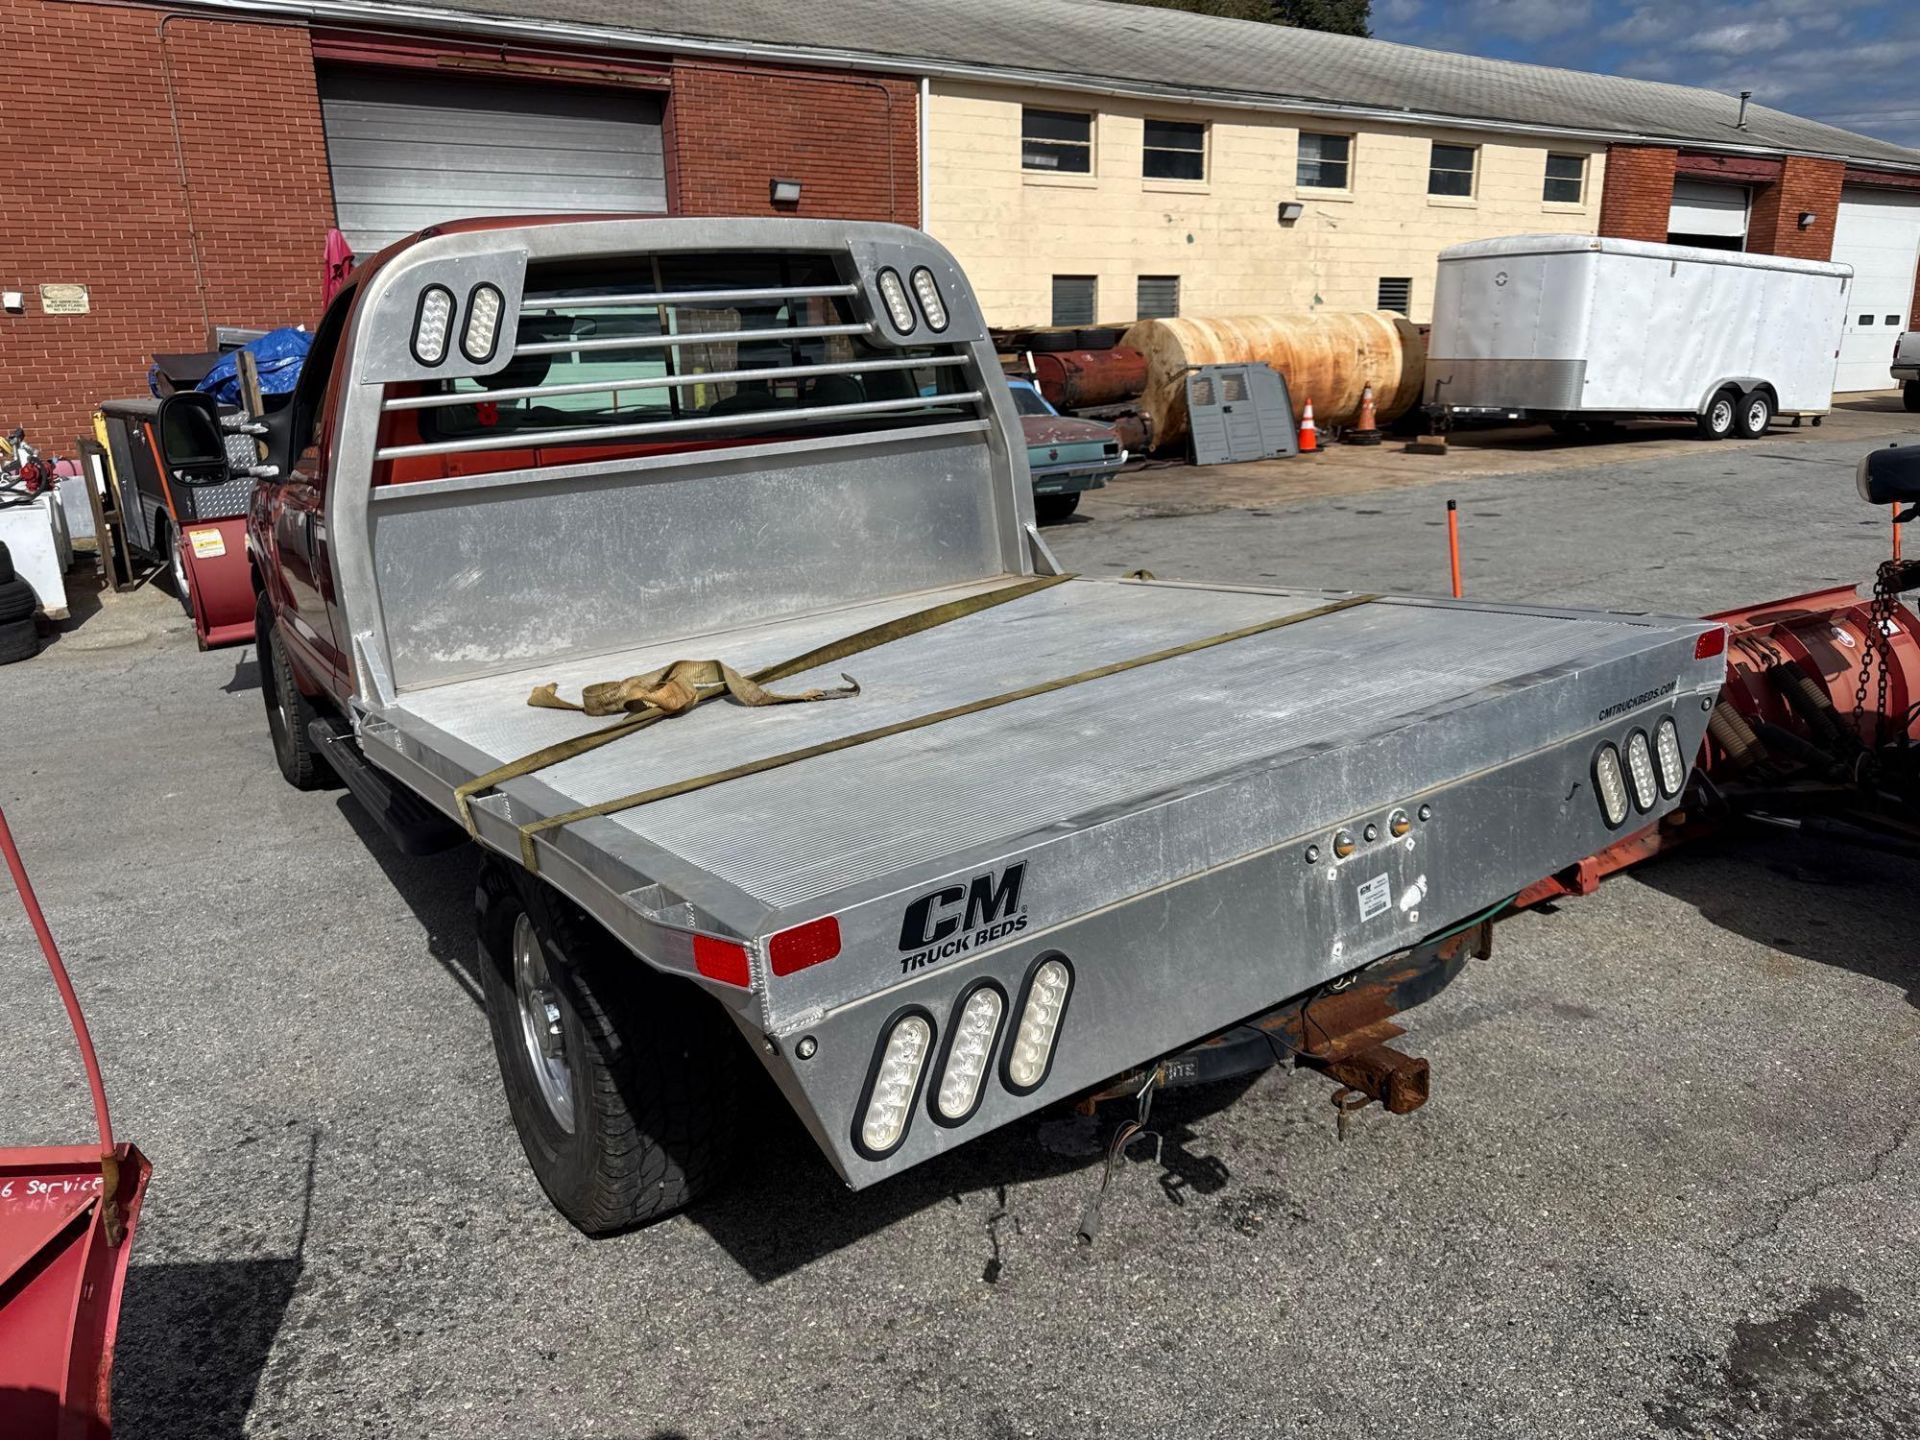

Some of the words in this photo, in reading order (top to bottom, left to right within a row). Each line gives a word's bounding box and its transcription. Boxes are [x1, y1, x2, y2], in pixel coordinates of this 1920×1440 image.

[1598, 679, 1678, 721] CMTRUCKBEDS.COM
[898, 859, 1028, 952] CM
[900, 935, 970, 974] TRUCK
[974, 914, 1028, 947] BEDS
